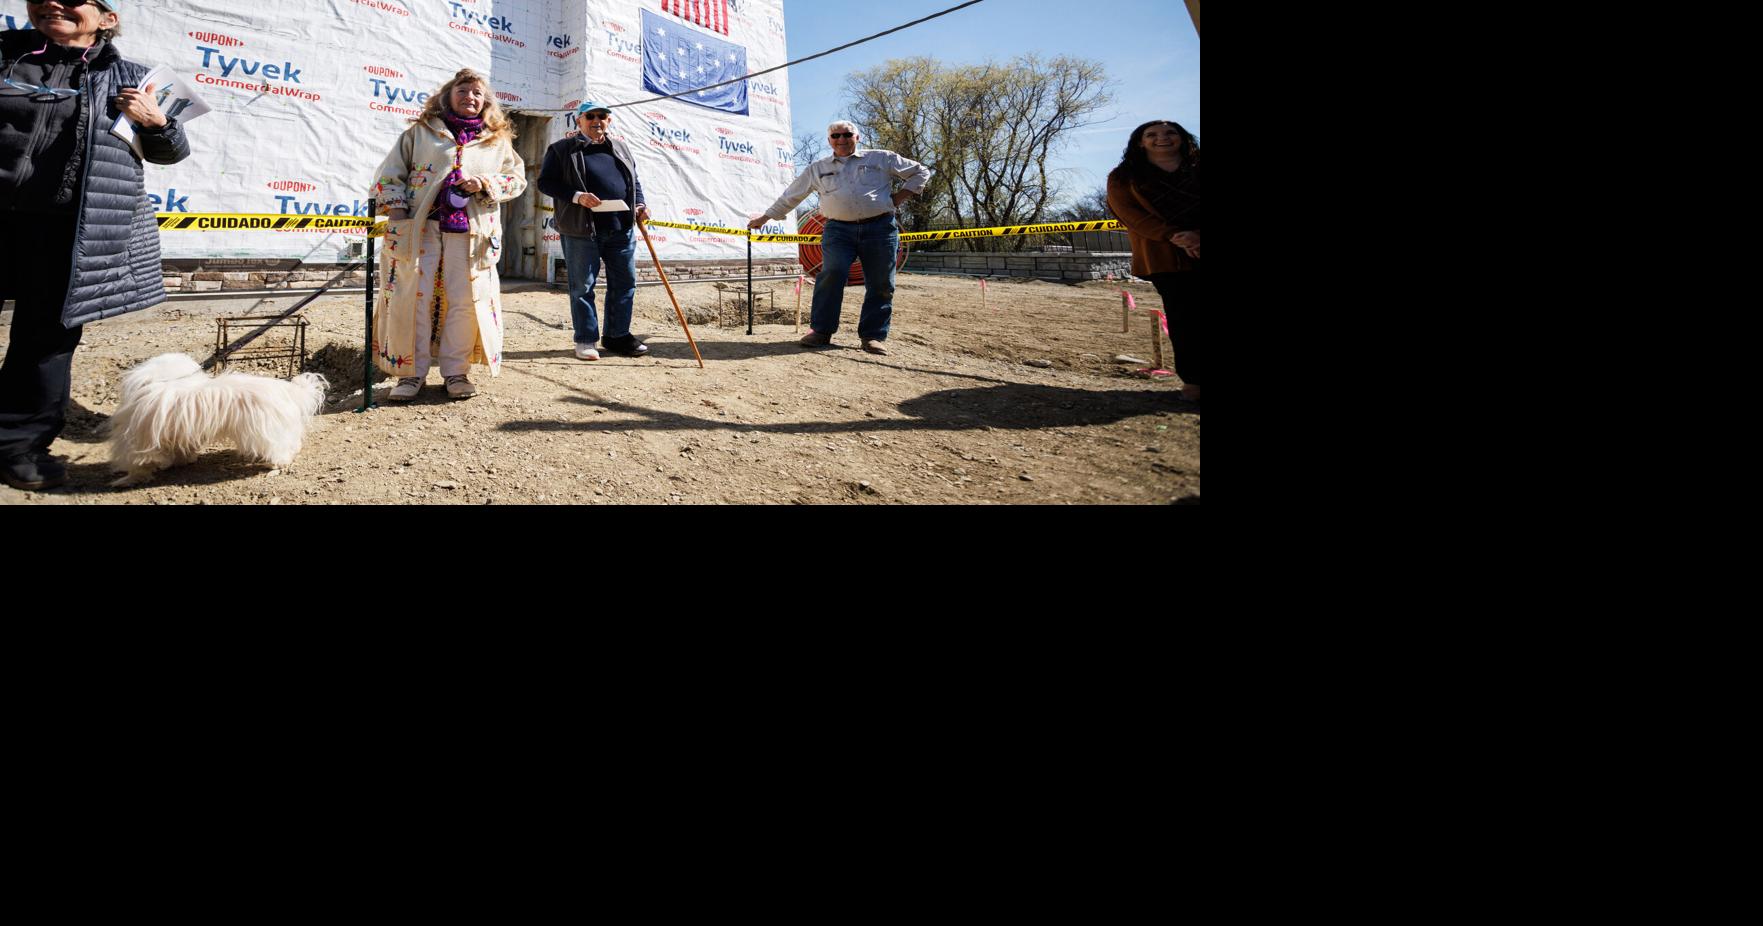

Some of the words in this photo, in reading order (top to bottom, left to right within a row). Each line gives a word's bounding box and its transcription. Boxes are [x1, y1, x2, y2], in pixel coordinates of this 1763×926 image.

[449, 1, 513, 33] Tyvek
[195, 31, 239, 47] DUPONT
[196, 45, 302, 84] Tyvek
[368, 65, 399, 79] DUPONT
[195, 73, 321, 101] CommercialWrap
[718, 135, 754, 155] Tyvek
[273, 181, 312, 193] DUPONT
[198, 216, 271, 229] CUIDADO
[775, 235, 809, 243] CUIDADO
[953, 229, 993, 238] CAUTION
[1028, 223, 1076, 234] CUIDADO
